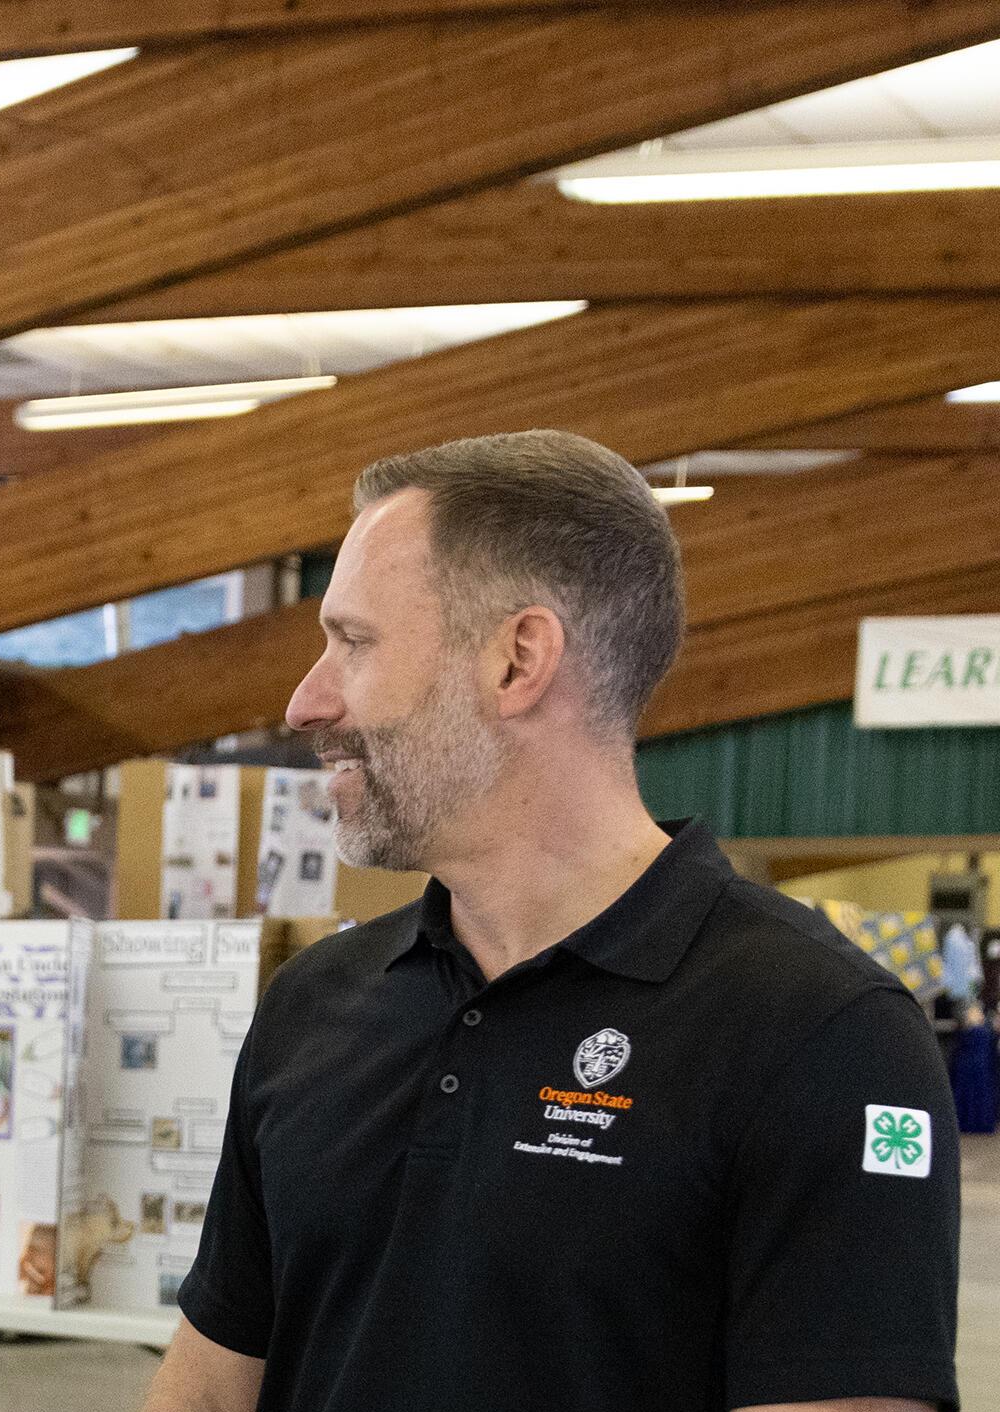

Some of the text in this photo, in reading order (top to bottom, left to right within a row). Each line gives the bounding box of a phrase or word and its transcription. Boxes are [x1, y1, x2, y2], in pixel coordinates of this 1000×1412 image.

[873, 647, 1000, 690] LEAR
[539, 1086, 633, 1110] Oregon State
[543, 1104, 617, 1129] University
[547, 1132, 594, 1148] Division of
